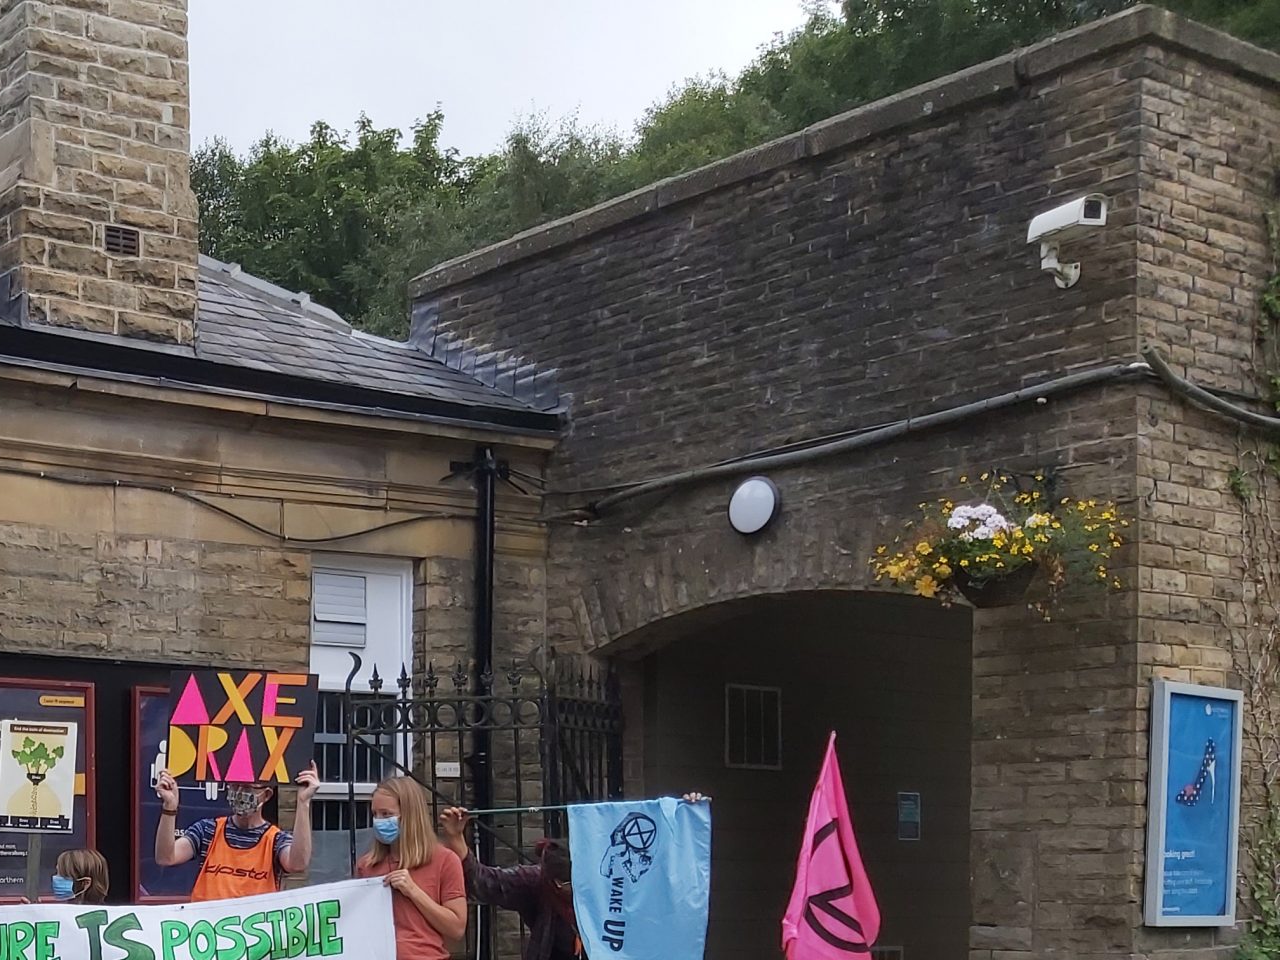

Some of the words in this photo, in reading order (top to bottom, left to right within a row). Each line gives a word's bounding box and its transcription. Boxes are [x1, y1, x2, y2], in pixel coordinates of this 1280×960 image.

[169, 672, 308, 728] AXE
[167, 725, 294, 784] DRAX
[609, 877, 624, 913] WAKE
[602, 919, 626, 952] UP
